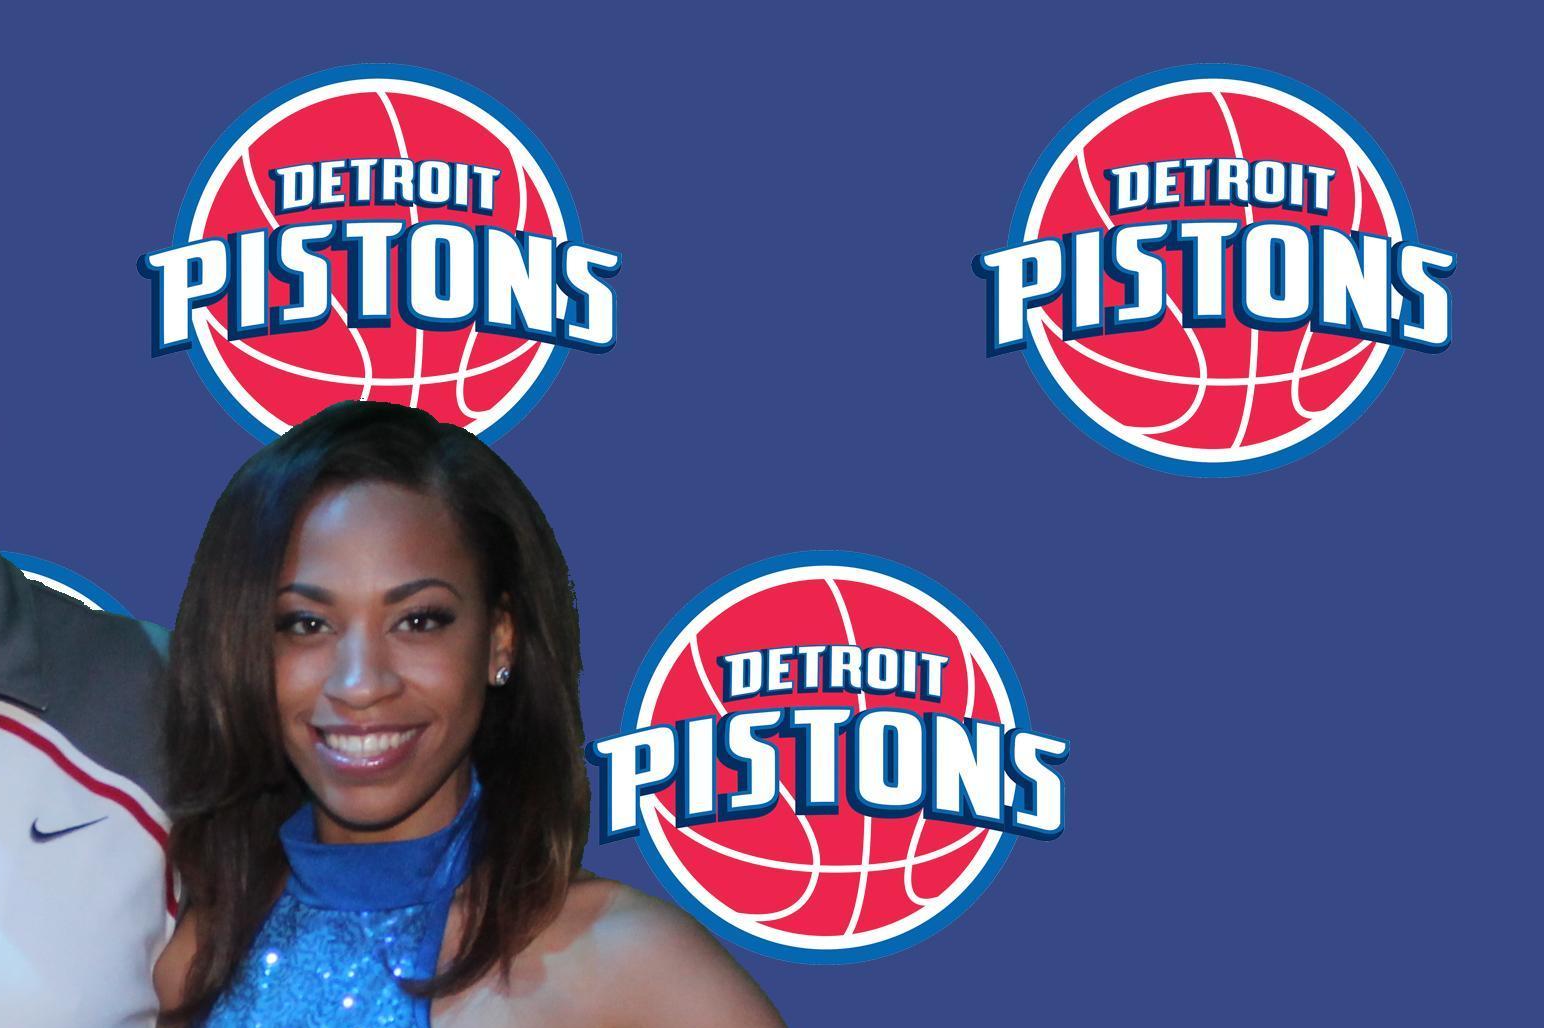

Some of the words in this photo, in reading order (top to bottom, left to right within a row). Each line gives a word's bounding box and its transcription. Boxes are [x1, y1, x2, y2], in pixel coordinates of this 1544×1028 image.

[269, 157, 501, 215] DETROIT
[1104, 157, 1336, 215] DETROIT
[137, 220, 622, 358] PISTONS
[972, 220, 1457, 358] PISTONS
[717, 644, 949, 702] DETROIT
[585, 707, 1070, 845] PISTONS
